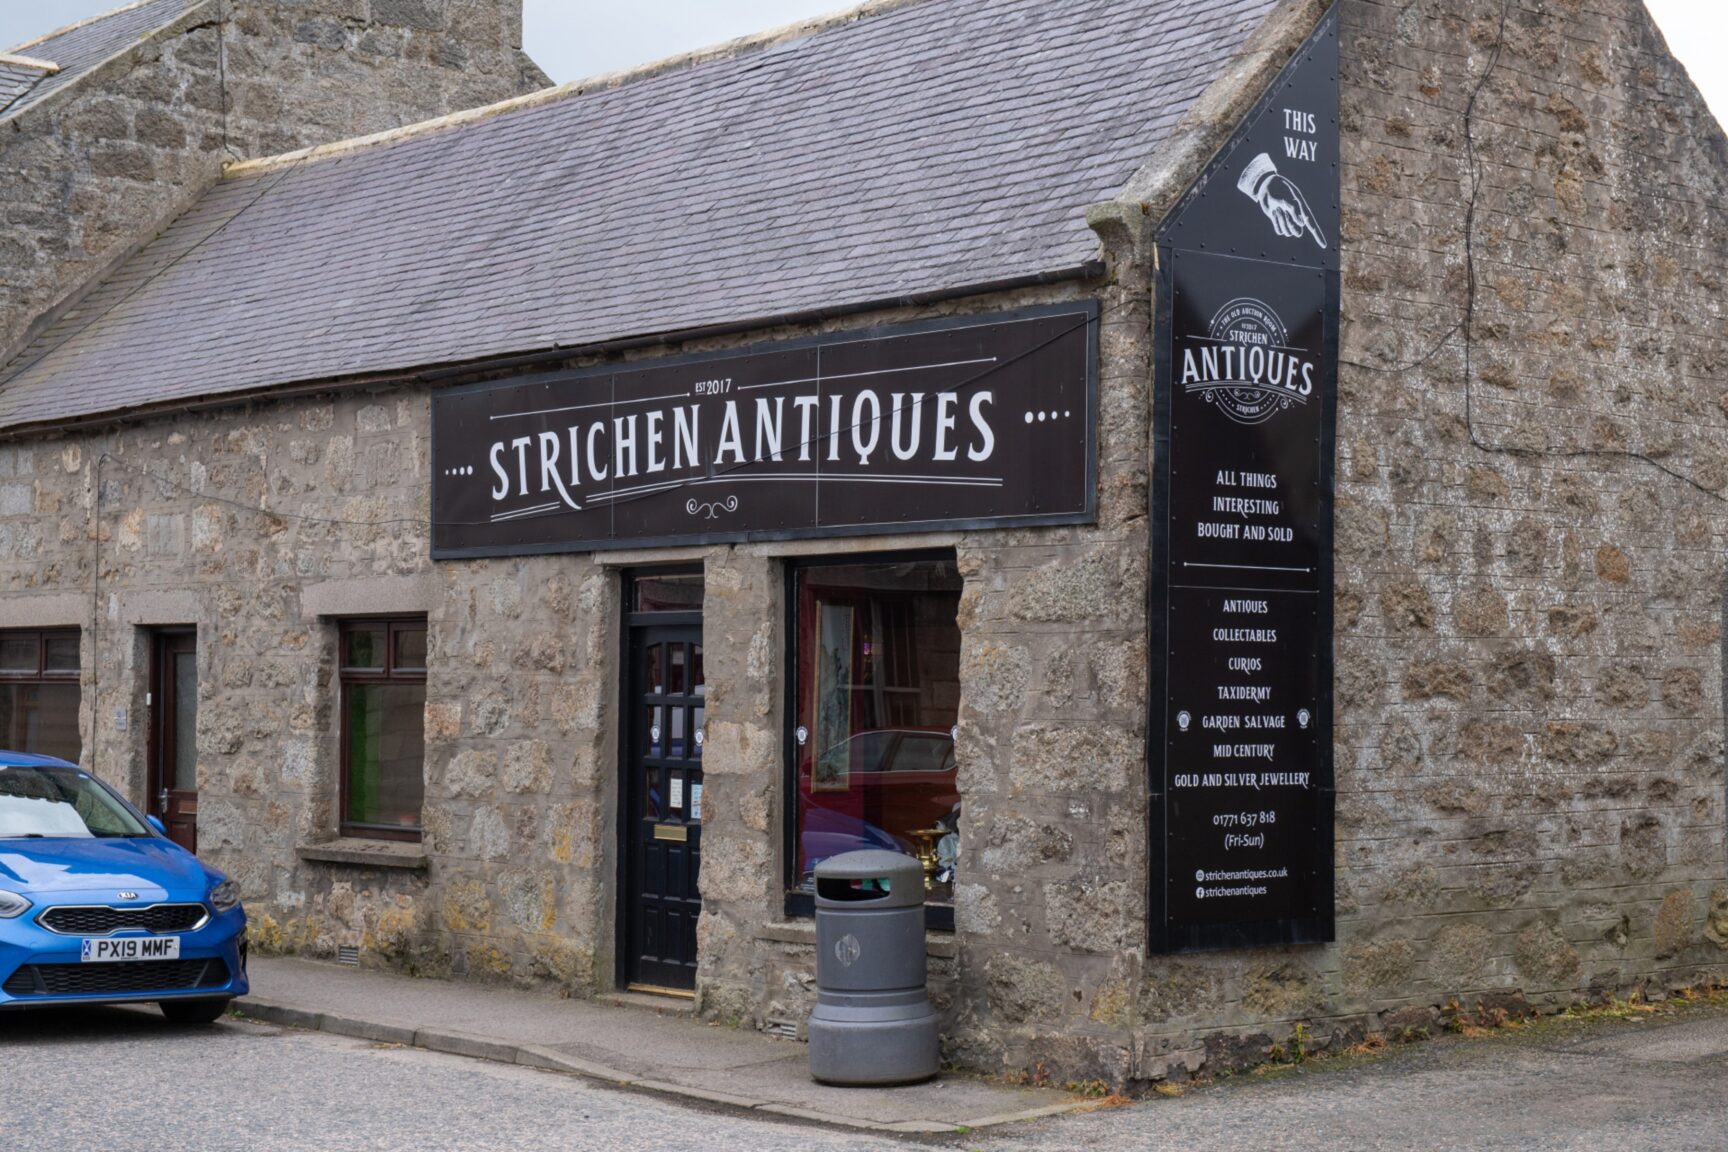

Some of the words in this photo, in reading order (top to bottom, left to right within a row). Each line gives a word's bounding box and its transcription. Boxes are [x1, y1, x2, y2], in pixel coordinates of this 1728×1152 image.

[1283, 109, 1316, 134] THIS
[1284, 136, 1317, 162] WAY
[1231, 308, 1240, 318] OLD
[1241, 307, 1262, 319] AUCTION
[1263, 316, 1276, 332] ROOM
[1229, 330, 1268, 347] STRICHEN
[1181, 346, 1314, 396] ANTIQUES
[695, 381, 706, 393] EST
[707, 378, 731, 395] 2017
[489, 404, 701, 510] STRICHEN
[713, 389, 995, 465] ANTIQUES
[1216, 470, 1237, 486] ALL
[1240, 472, 1277, 488] THINGS
[1213, 496, 1279, 518] INTERESTING
[1197, 522, 1240, 539] BOUGHT
[1243, 525, 1265, 541] AND
[1267, 527, 1293, 542] SOLD
[1223, 600, 1268, 614] ANTIQUES
[1213, 628, 1277, 642] COLLECTABLES
[1228, 657, 1262, 675] CURIOS
[1217, 686, 1272, 704] TAXIDERMY
[1202, 715, 1240, 733] GARDEN
[1244, 715, 1286, 728] SALVAGE
[1213, 744, 1232, 758] MID
[1233, 744, 1275, 761] CENTURY
[1174, 774, 1199, 787] GOLD
[1201, 774, 1222, 787] AND
[1224, 773, 1260, 790] SILVER
[1259, 772, 1310, 790] JEWELLERY
[1213, 814, 1238, 827] 01771
[1240, 812, 1257, 827] 637
[1259, 811, 1276, 824] 818
[1224, 832, 1265, 851] (Fri-Sun)
[1205, 867, 1288, 882] strichenantiques.co.uk
[1205, 885, 1267, 898] strichenantiques
[97, 940, 138, 958] PX19
[141, 939, 174, 956] MMF
